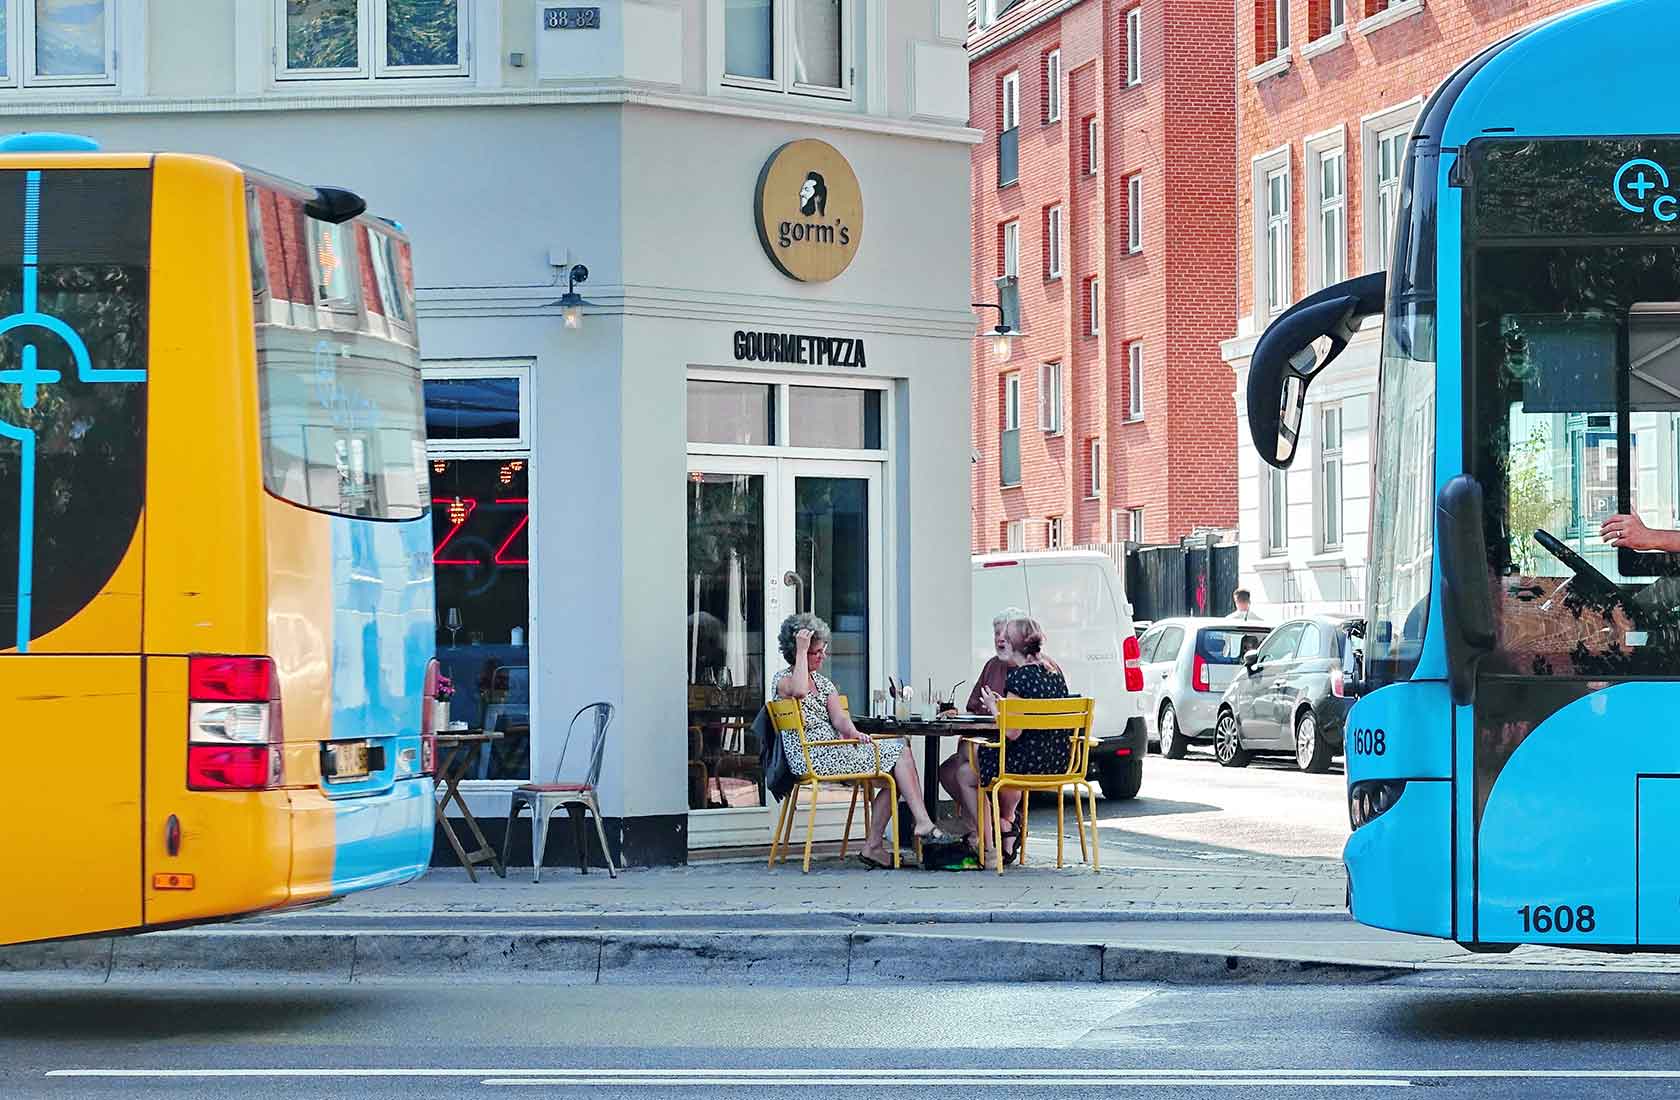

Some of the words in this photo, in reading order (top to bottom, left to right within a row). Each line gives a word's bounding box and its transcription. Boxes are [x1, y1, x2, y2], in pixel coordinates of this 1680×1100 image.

[779, 218, 850, 248] gorm's
[734, 330, 866, 368] GOURMETPIZZA
[1354, 728, 1386, 756] 1608
[1518, 904, 1596, 933] 1608
